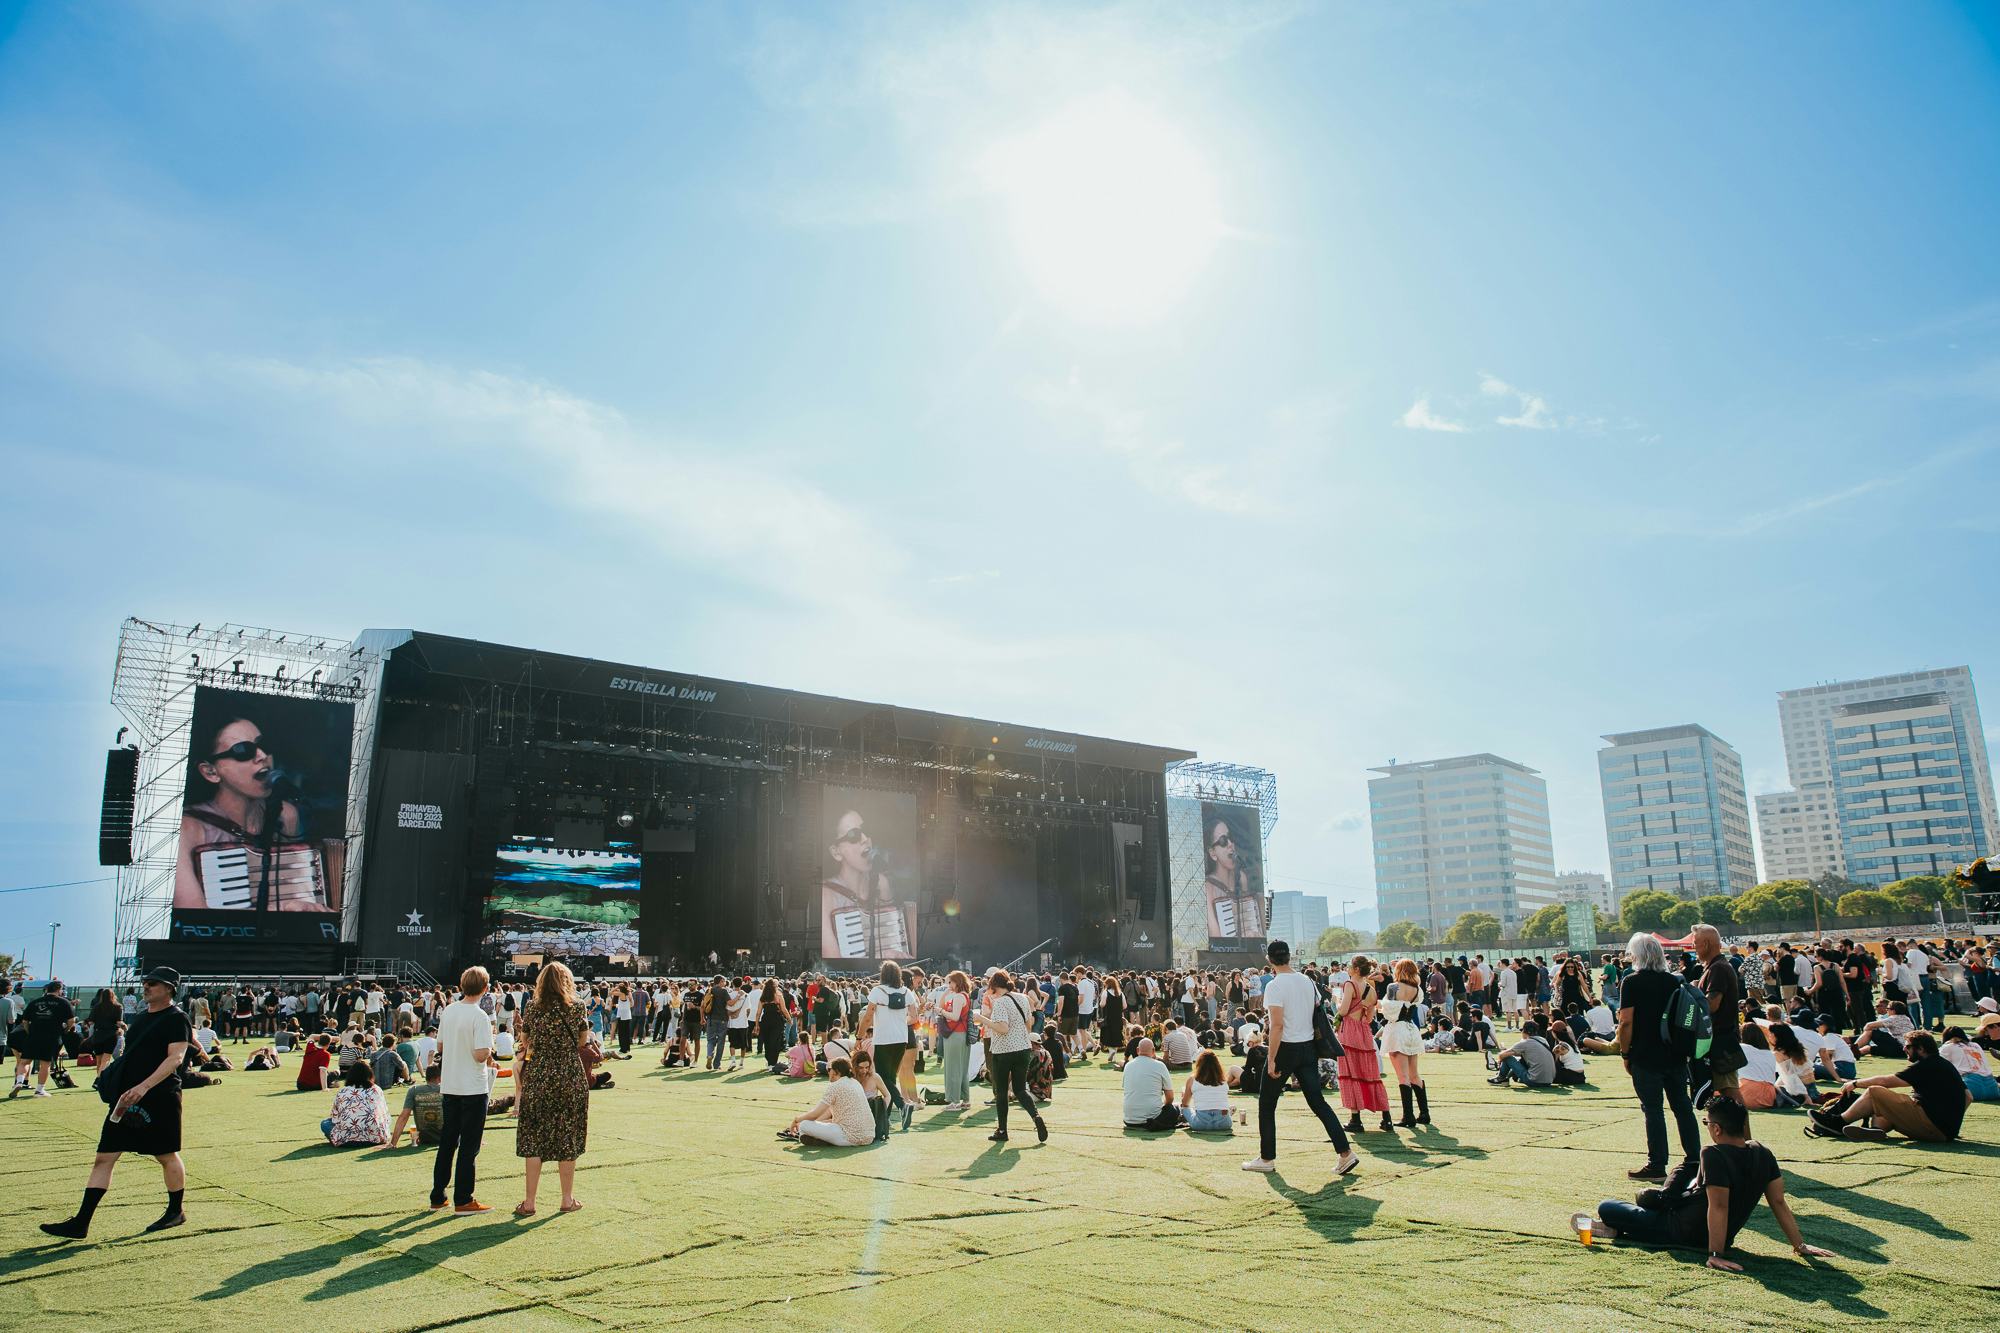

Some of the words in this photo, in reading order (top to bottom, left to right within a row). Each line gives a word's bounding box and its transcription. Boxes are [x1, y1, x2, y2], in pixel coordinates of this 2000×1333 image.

[609, 676, 676, 697] ESTRELLA
[679, 687, 717, 702] DAMM
[400, 803, 441, 814] PRIMAVERA
[398, 811, 423, 820] SOUND
[424, 813, 443, 822] 2023
[398, 820, 442, 830] BARCELONA
[397, 925, 432, 933] ESTRELLA
[1684, 1004, 1695, 1027] Wilson
